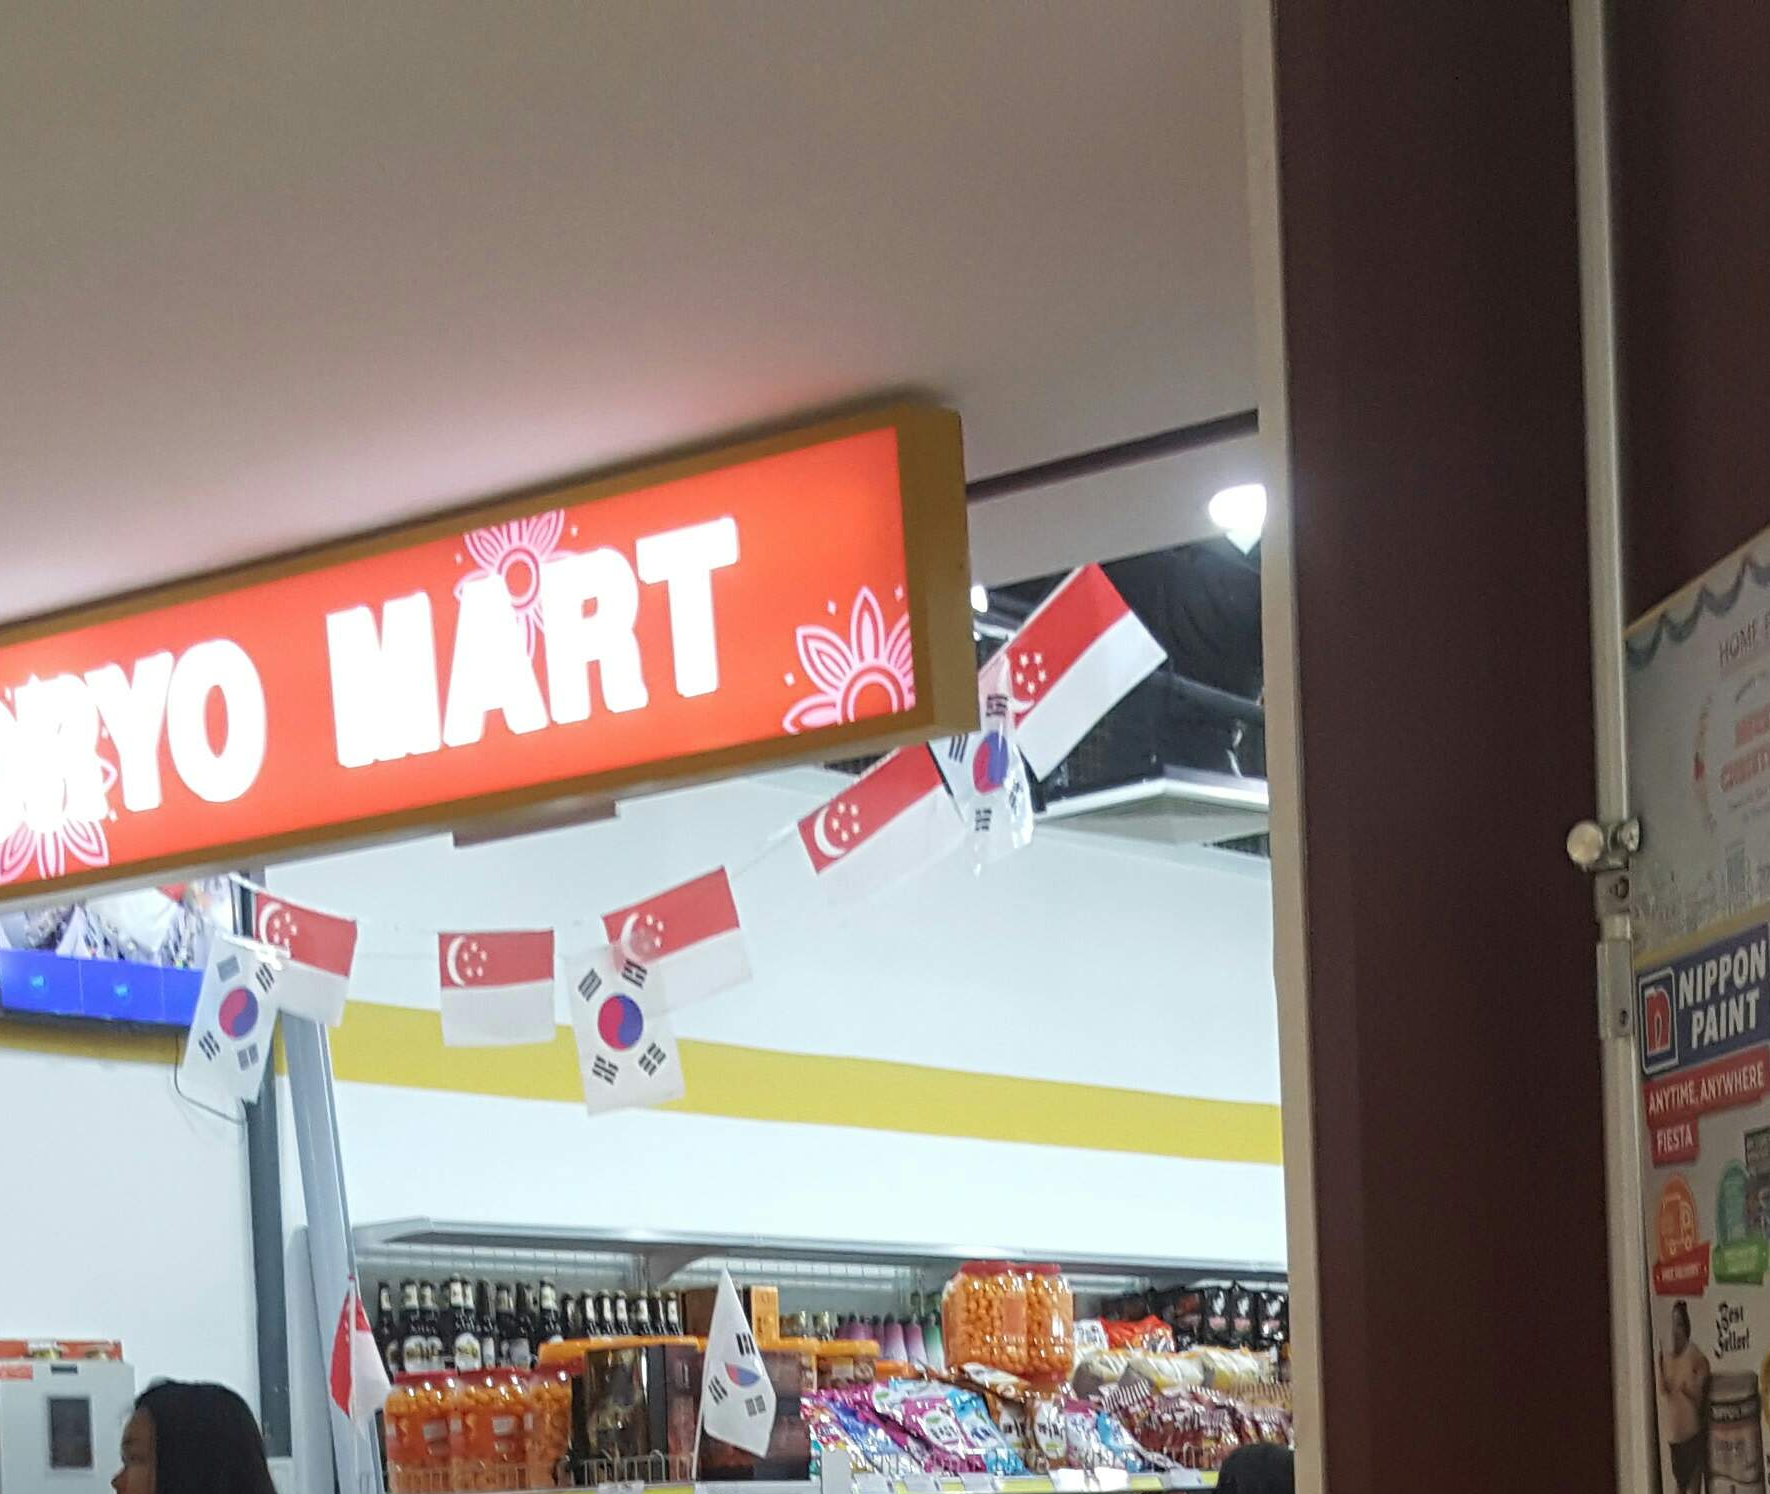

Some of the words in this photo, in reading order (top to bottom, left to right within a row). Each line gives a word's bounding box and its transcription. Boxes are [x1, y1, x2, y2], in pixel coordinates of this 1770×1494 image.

[327, 515, 739, 769] MART
[1678, 939, 1767, 1010] NIPPON
[1691, 988, 1760, 1050] PAINT
[1700, 1061, 1765, 1104] ANYWHERE
[1656, 1124, 1694, 1155] FIESTA
[1715, 1301, 1744, 1337] Best
